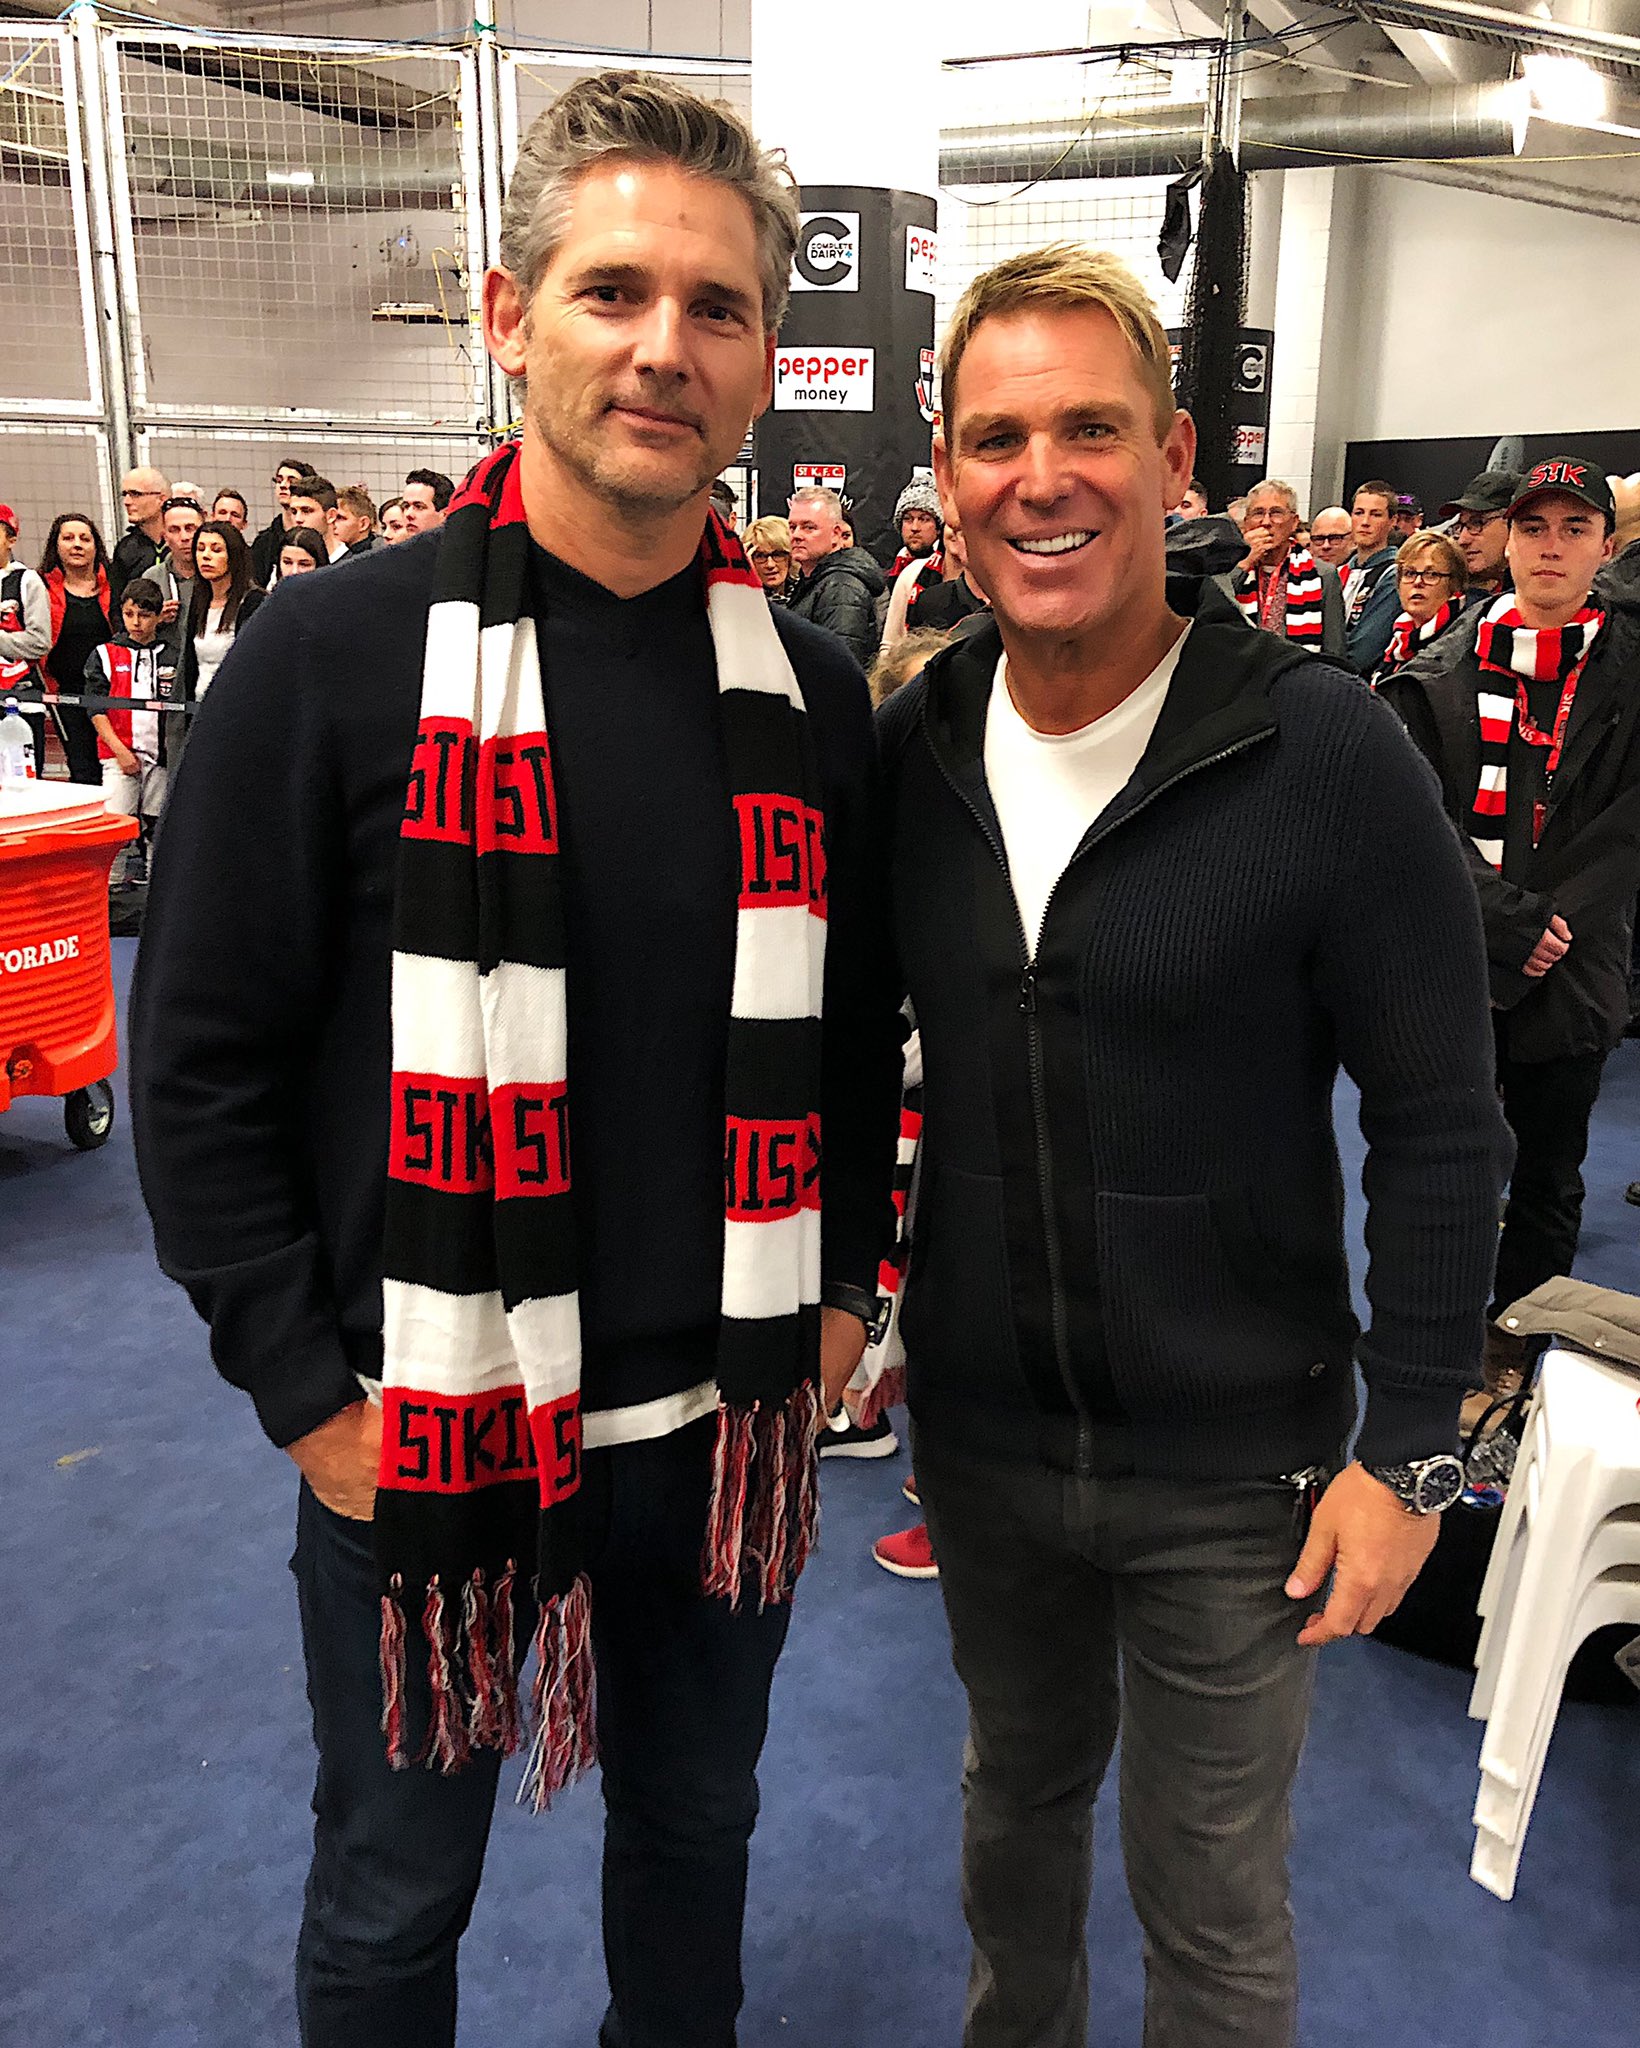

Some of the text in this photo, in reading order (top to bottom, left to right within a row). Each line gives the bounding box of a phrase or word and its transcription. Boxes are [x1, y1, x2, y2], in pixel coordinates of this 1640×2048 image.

[778, 357, 868, 384] pepper
[794, 388, 848, 404] money
[1527, 462, 1588, 489] STK
